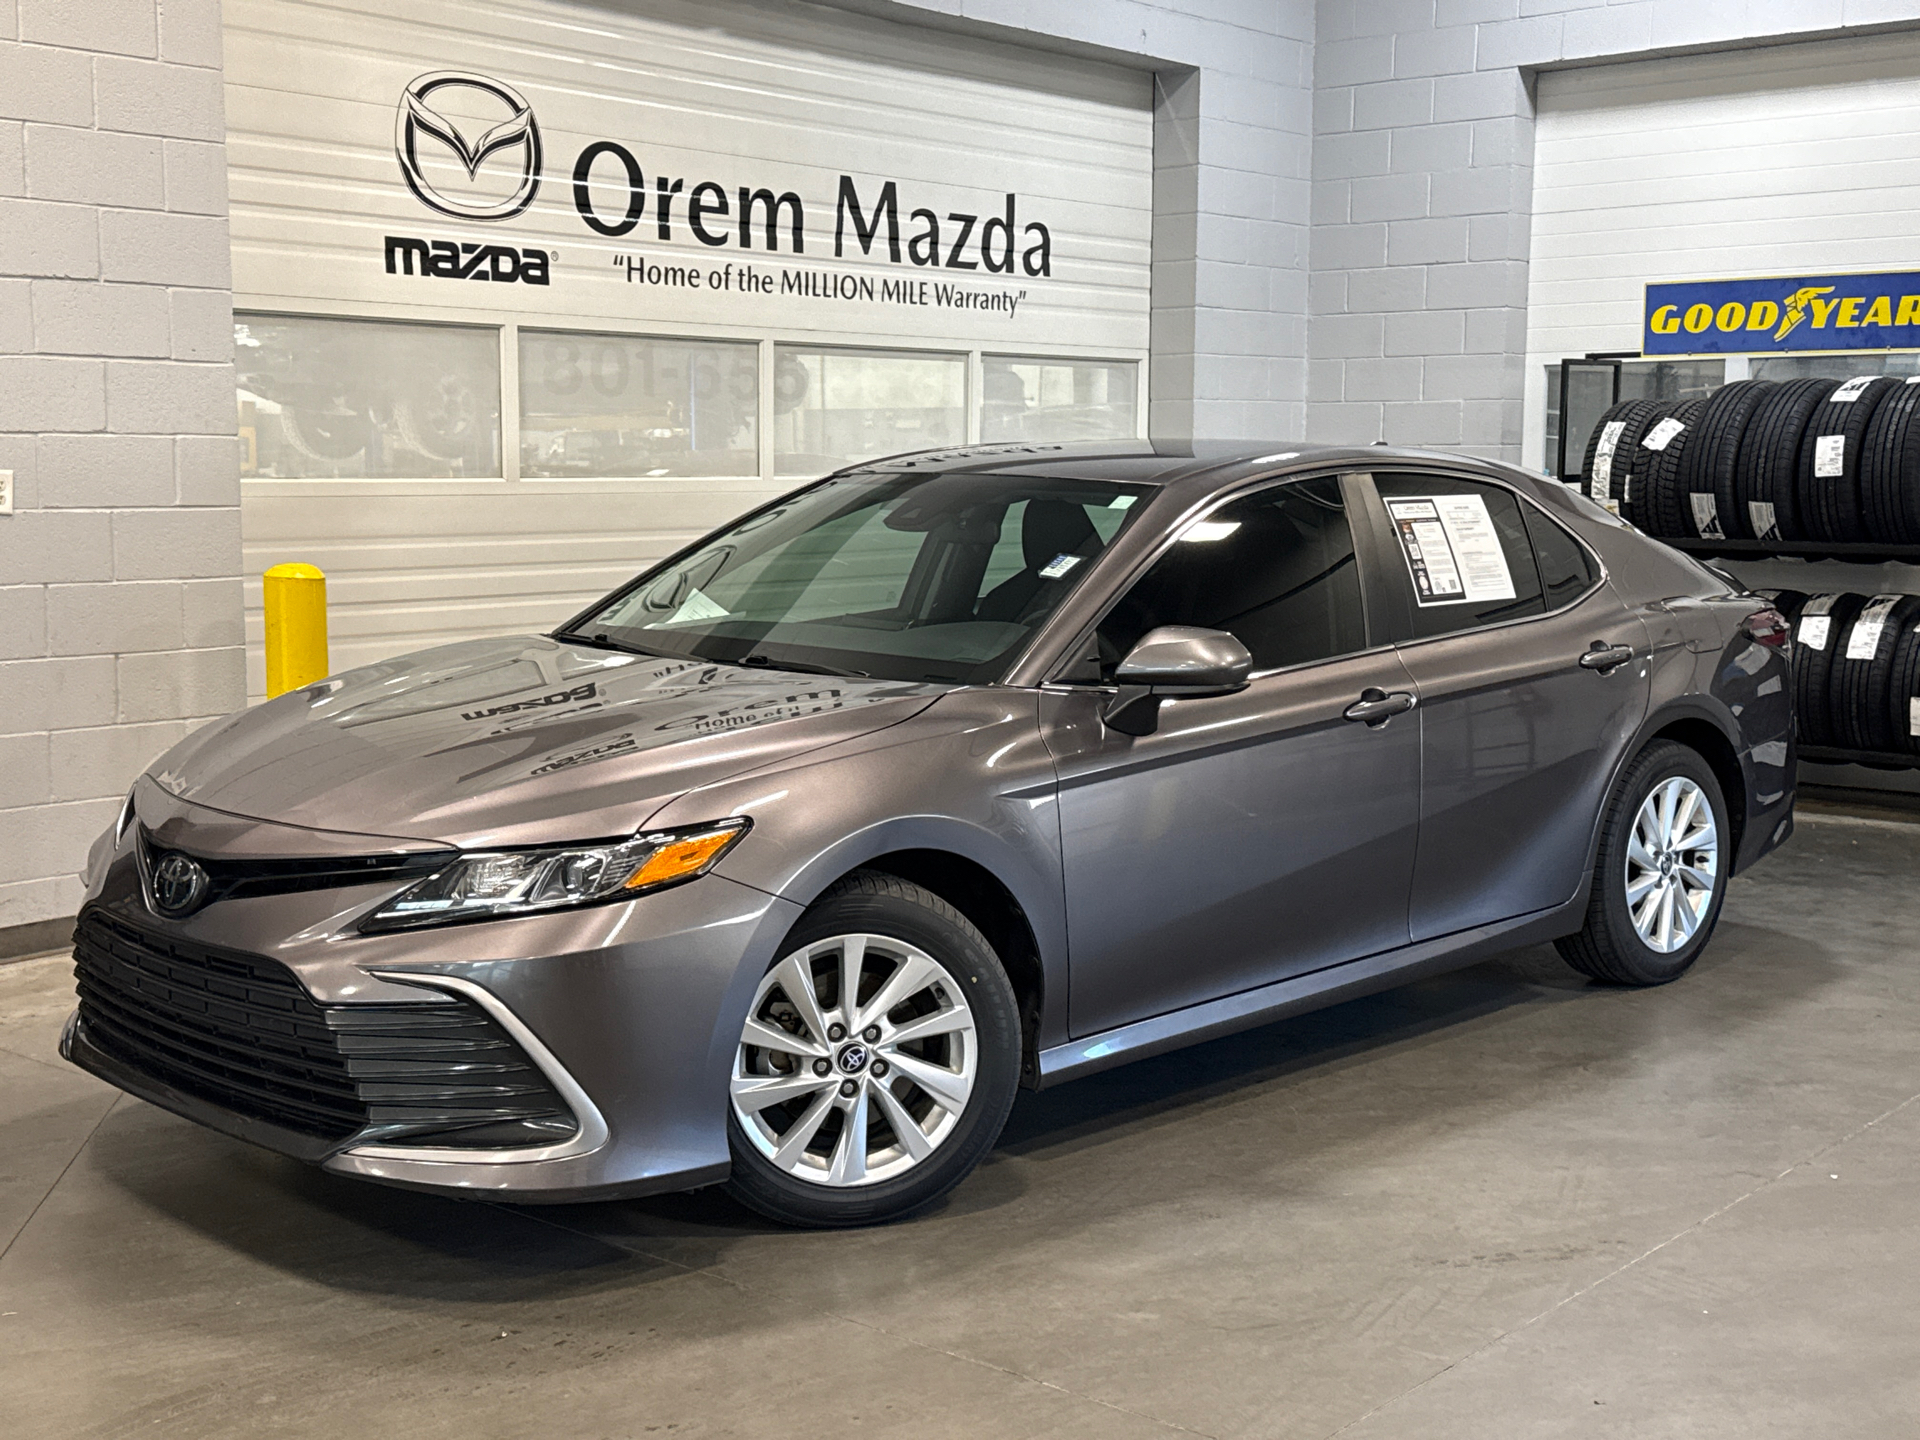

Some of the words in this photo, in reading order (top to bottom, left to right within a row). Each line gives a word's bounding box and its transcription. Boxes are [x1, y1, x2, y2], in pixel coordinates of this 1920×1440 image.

[572, 140, 805, 255] Orem
[833, 174, 1053, 278] Mazda
[708, 262, 733, 291] of
[736, 266, 775, 294] the
[780, 268, 875, 302] MILLION
[880, 278, 929, 307] MILE
